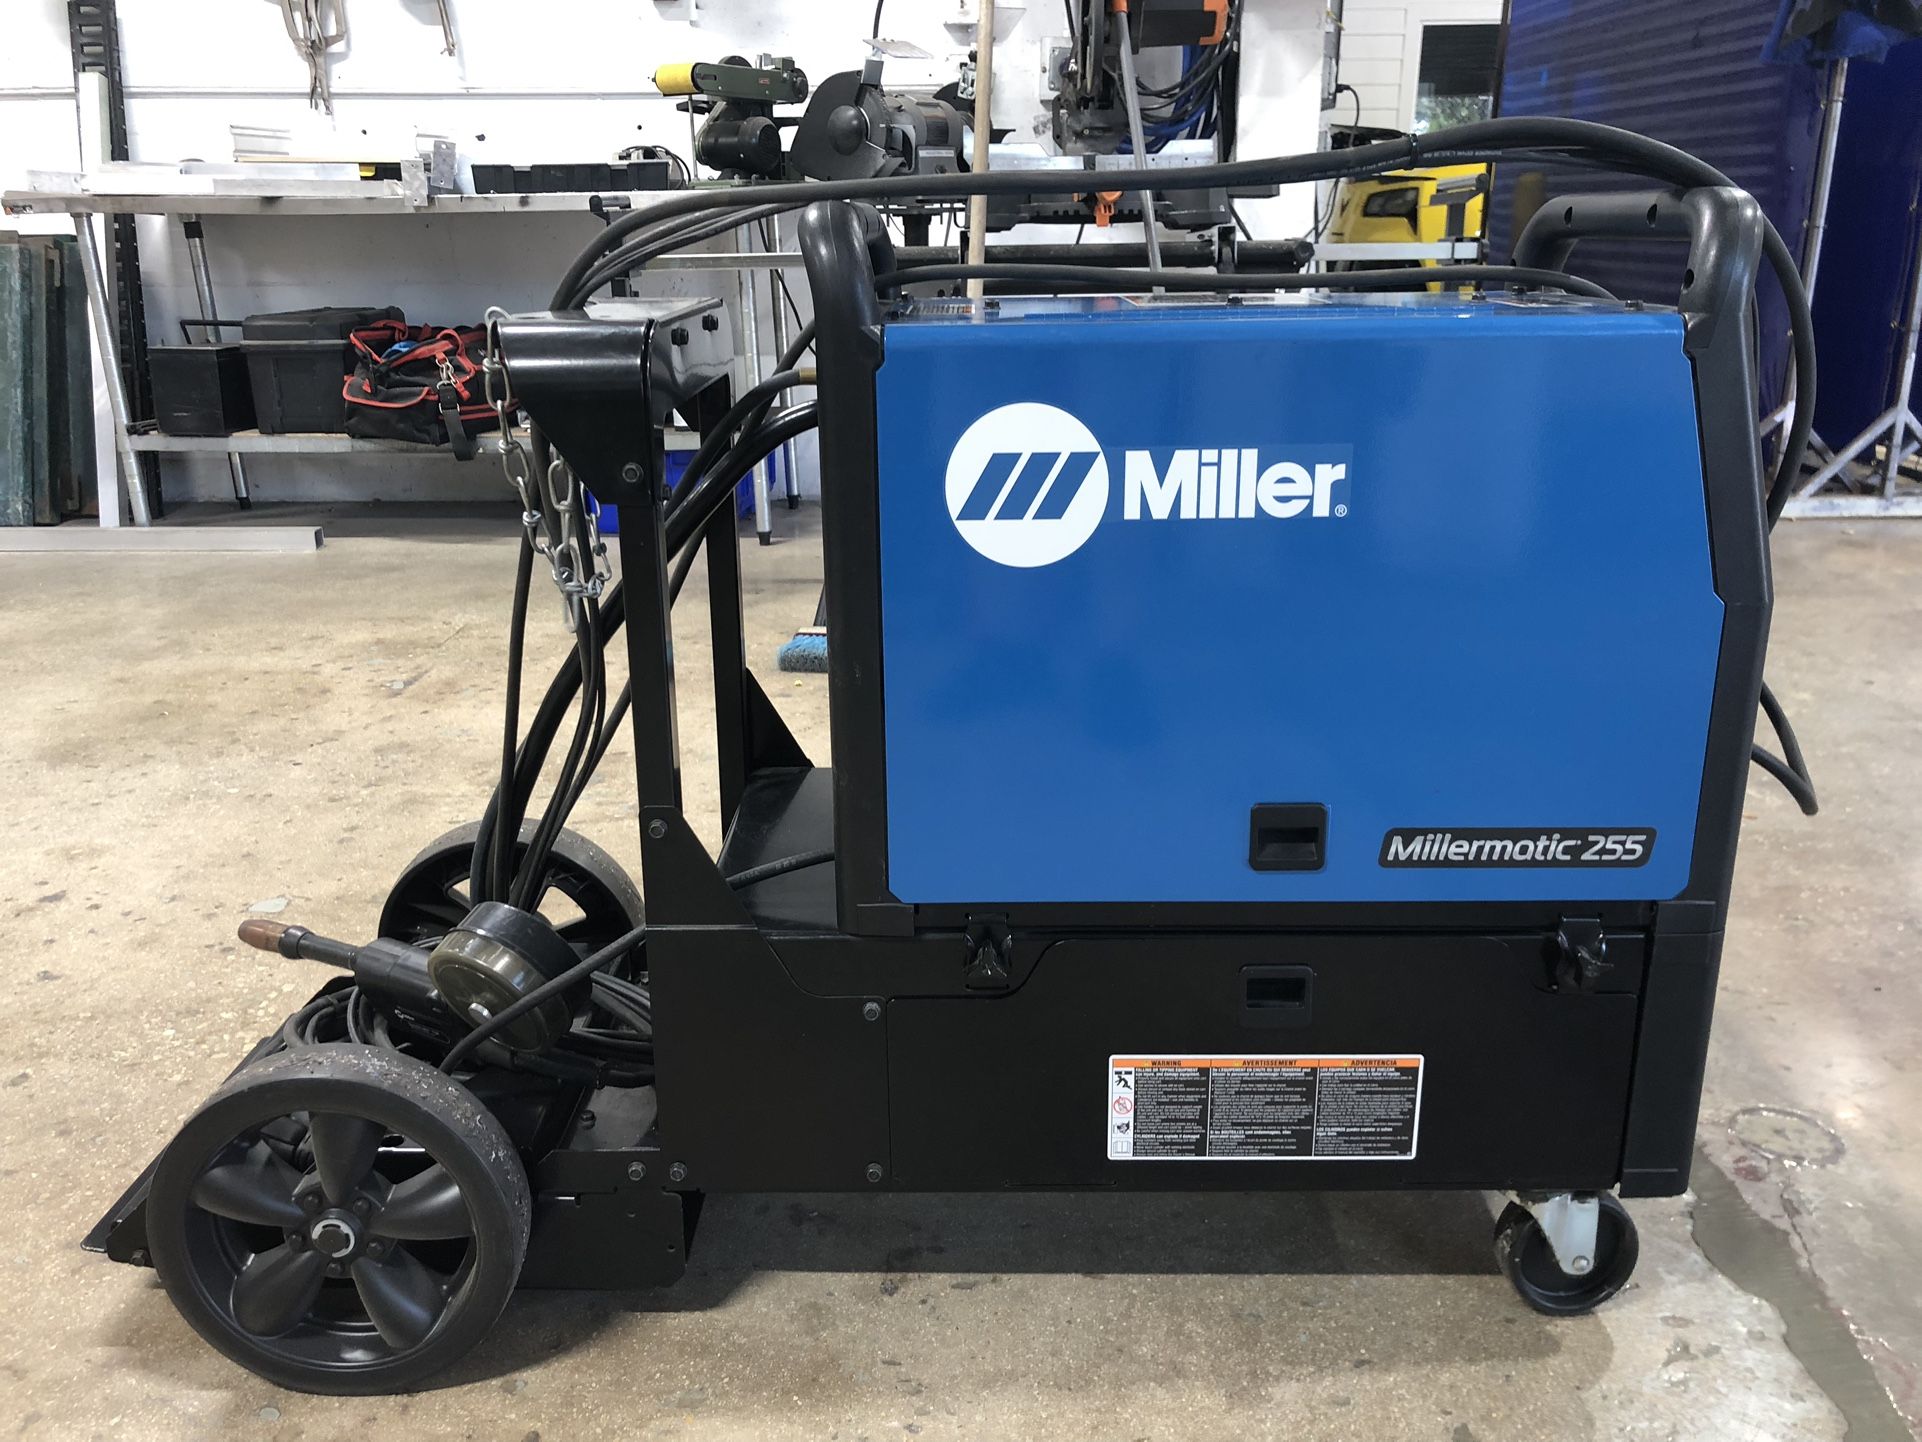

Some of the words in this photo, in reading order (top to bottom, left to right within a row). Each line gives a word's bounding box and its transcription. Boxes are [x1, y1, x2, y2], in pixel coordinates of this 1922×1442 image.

[1124, 448, 1346, 520] Miller
[1387, 833, 1577, 861] Millermatic
[1580, 835, 1647, 861] 255
